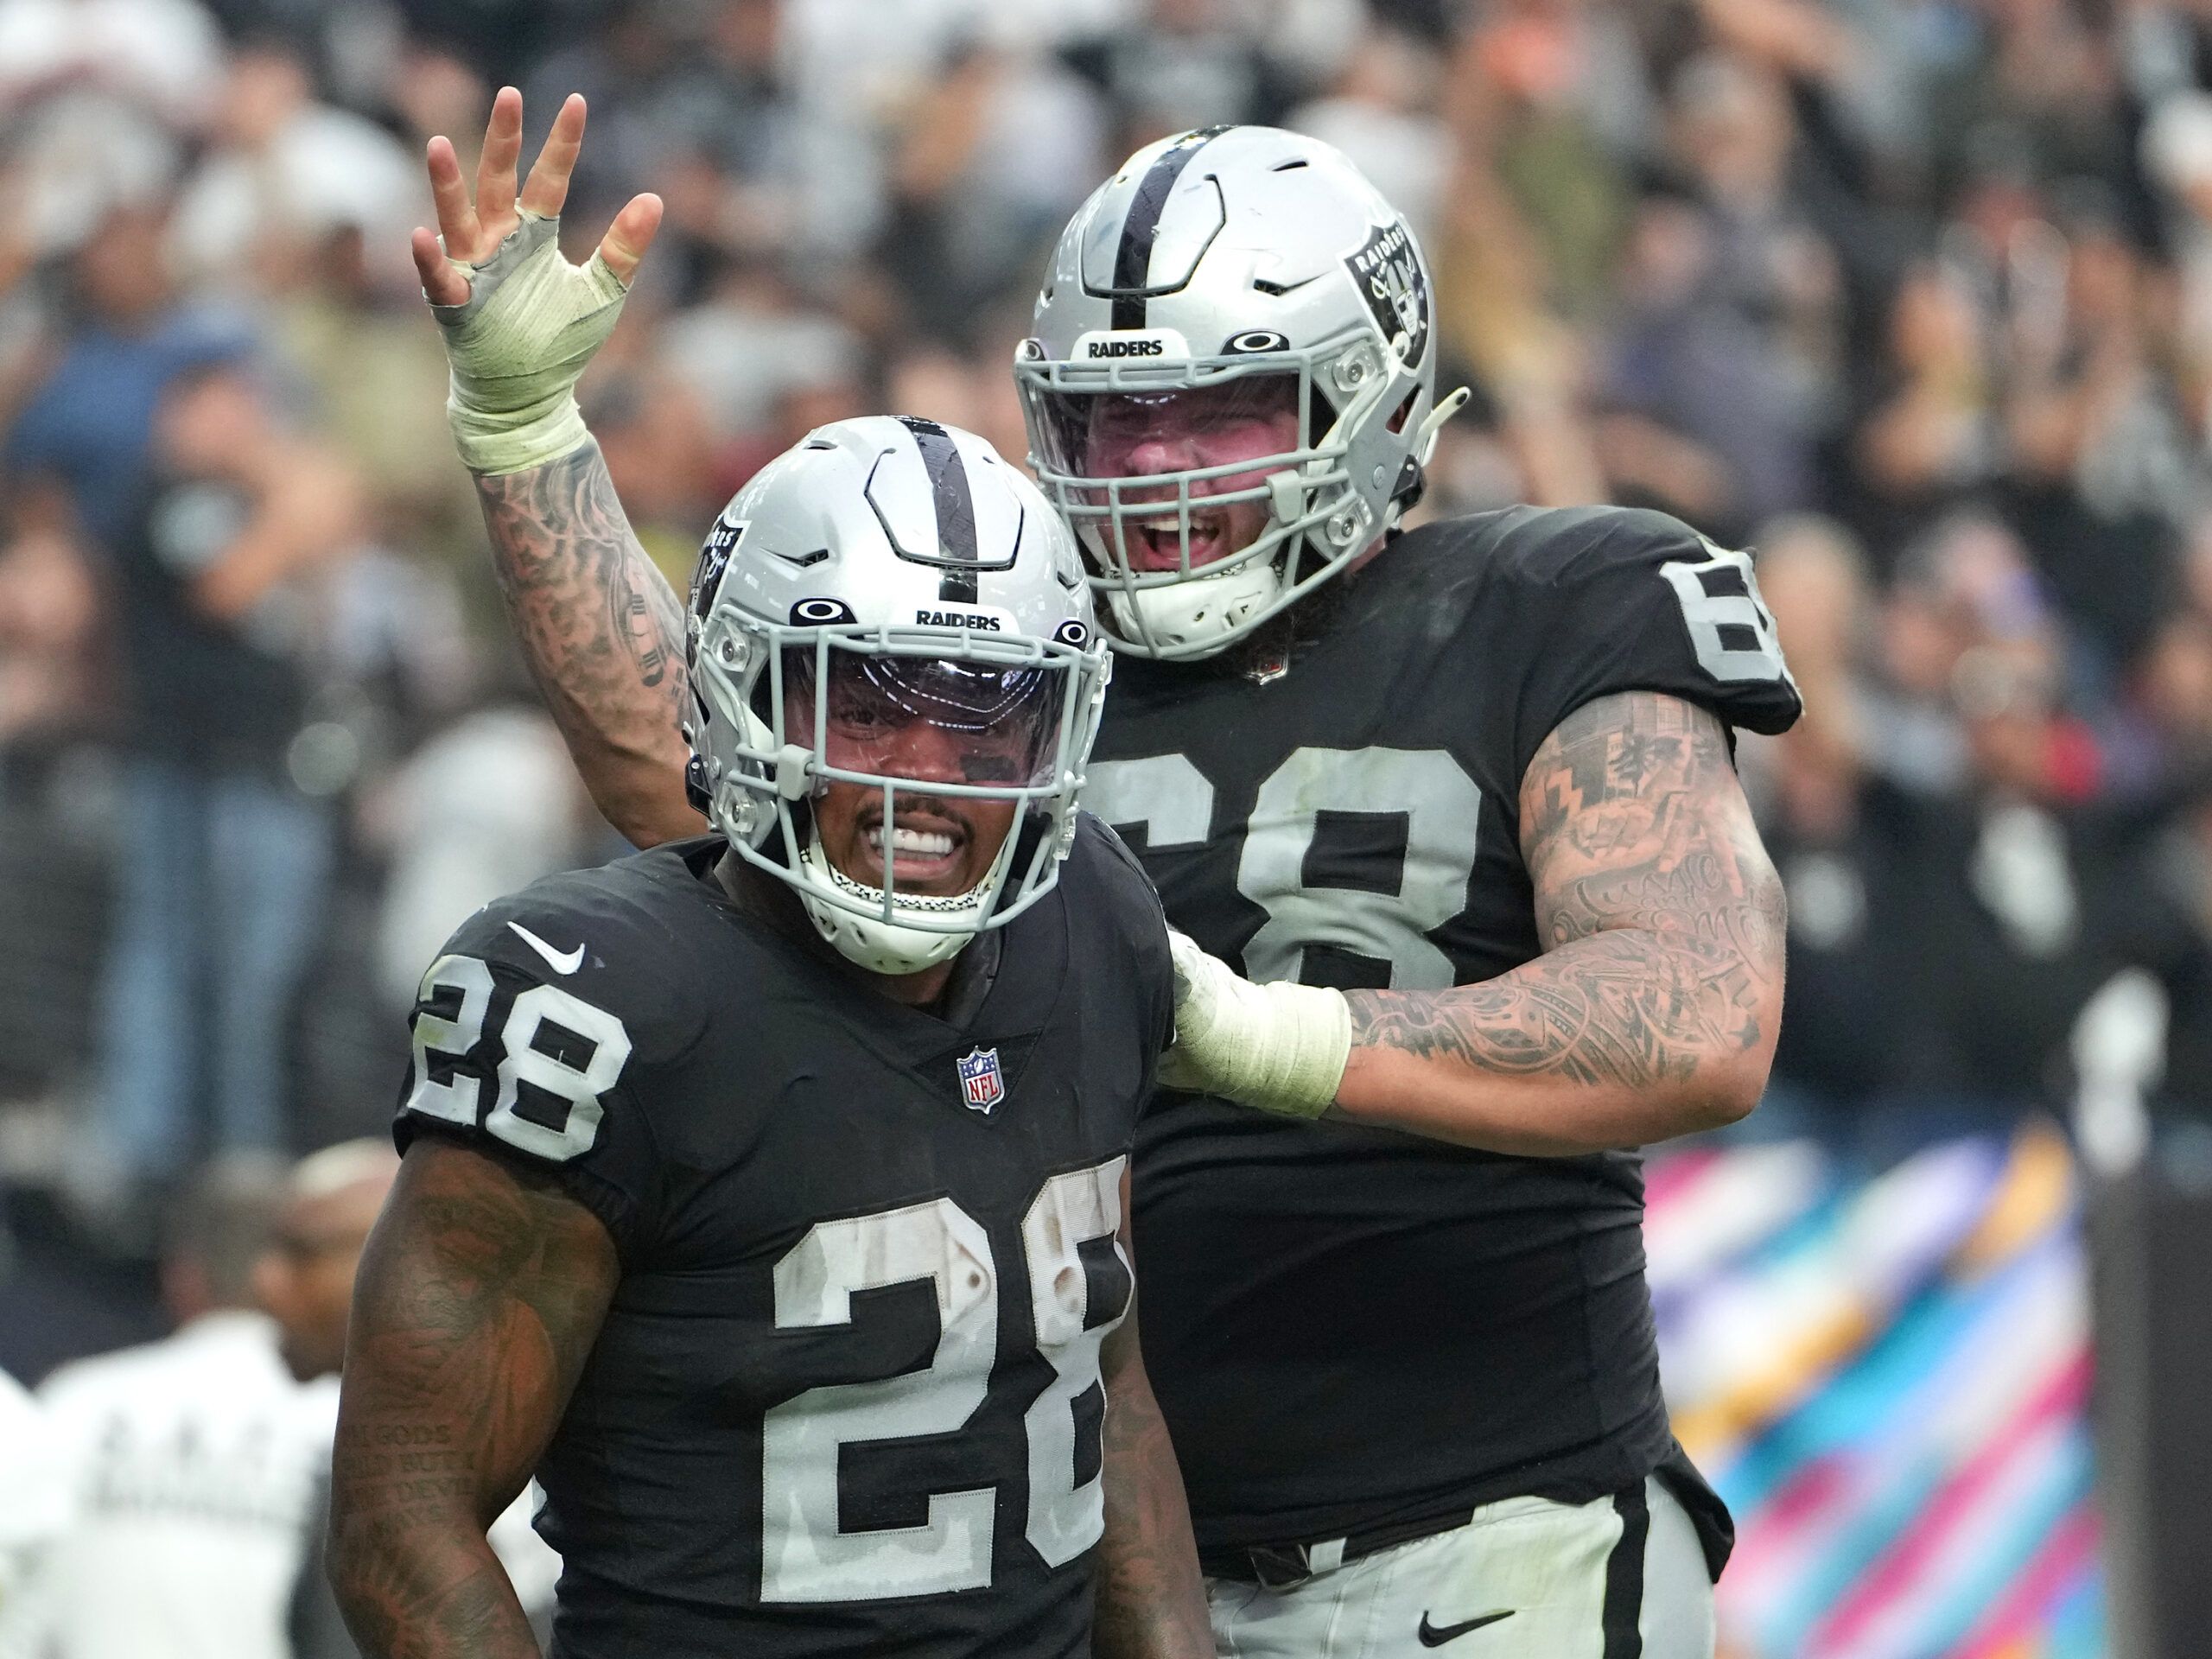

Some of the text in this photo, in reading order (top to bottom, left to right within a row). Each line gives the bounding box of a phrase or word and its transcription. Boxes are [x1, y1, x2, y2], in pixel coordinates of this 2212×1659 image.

[1354, 226, 1405, 273] RAIDERS
[1088, 340, 1163, 358] RAIDERS
[916, 610, 1001, 632] RAIDERS
[407, 954, 632, 1161] 28
[968, 1074, 998, 1102] NFL
[760, 1153, 1135, 1604] 28
